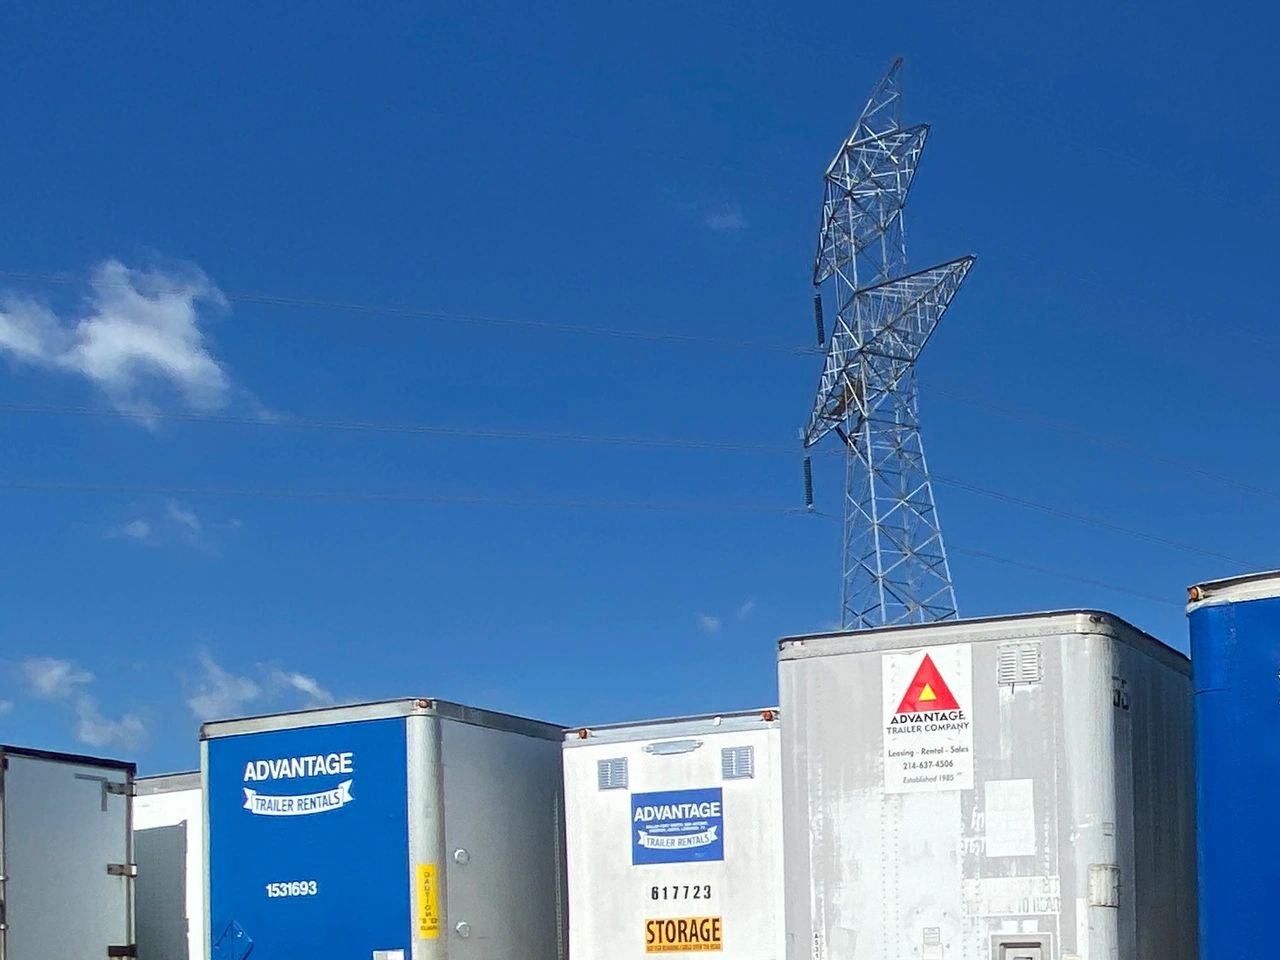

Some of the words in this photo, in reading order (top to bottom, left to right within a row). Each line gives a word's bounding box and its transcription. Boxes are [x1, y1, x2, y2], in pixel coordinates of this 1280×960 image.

[890, 710, 967, 724] ADVANTAGE
[886, 726, 922, 735] TRAILER
[924, 722, 970, 732] COMPANY
[888, 749, 914, 757] Leasing
[950, 745, 969, 753] Sales
[243, 752, 354, 782] ADVANTAGE
[254, 797, 295, 812] TRAILER
[297, 791, 341, 811] RENTALS
[634, 801, 721, 822] ADVANTAGE
[646, 837, 676, 848] TRAILER
[677, 834, 710, 848] RENTALS
[266, 880, 318, 898] 1531693
[651, 885, 711, 900] 617723
[646, 918, 721, 944] STORAGE
